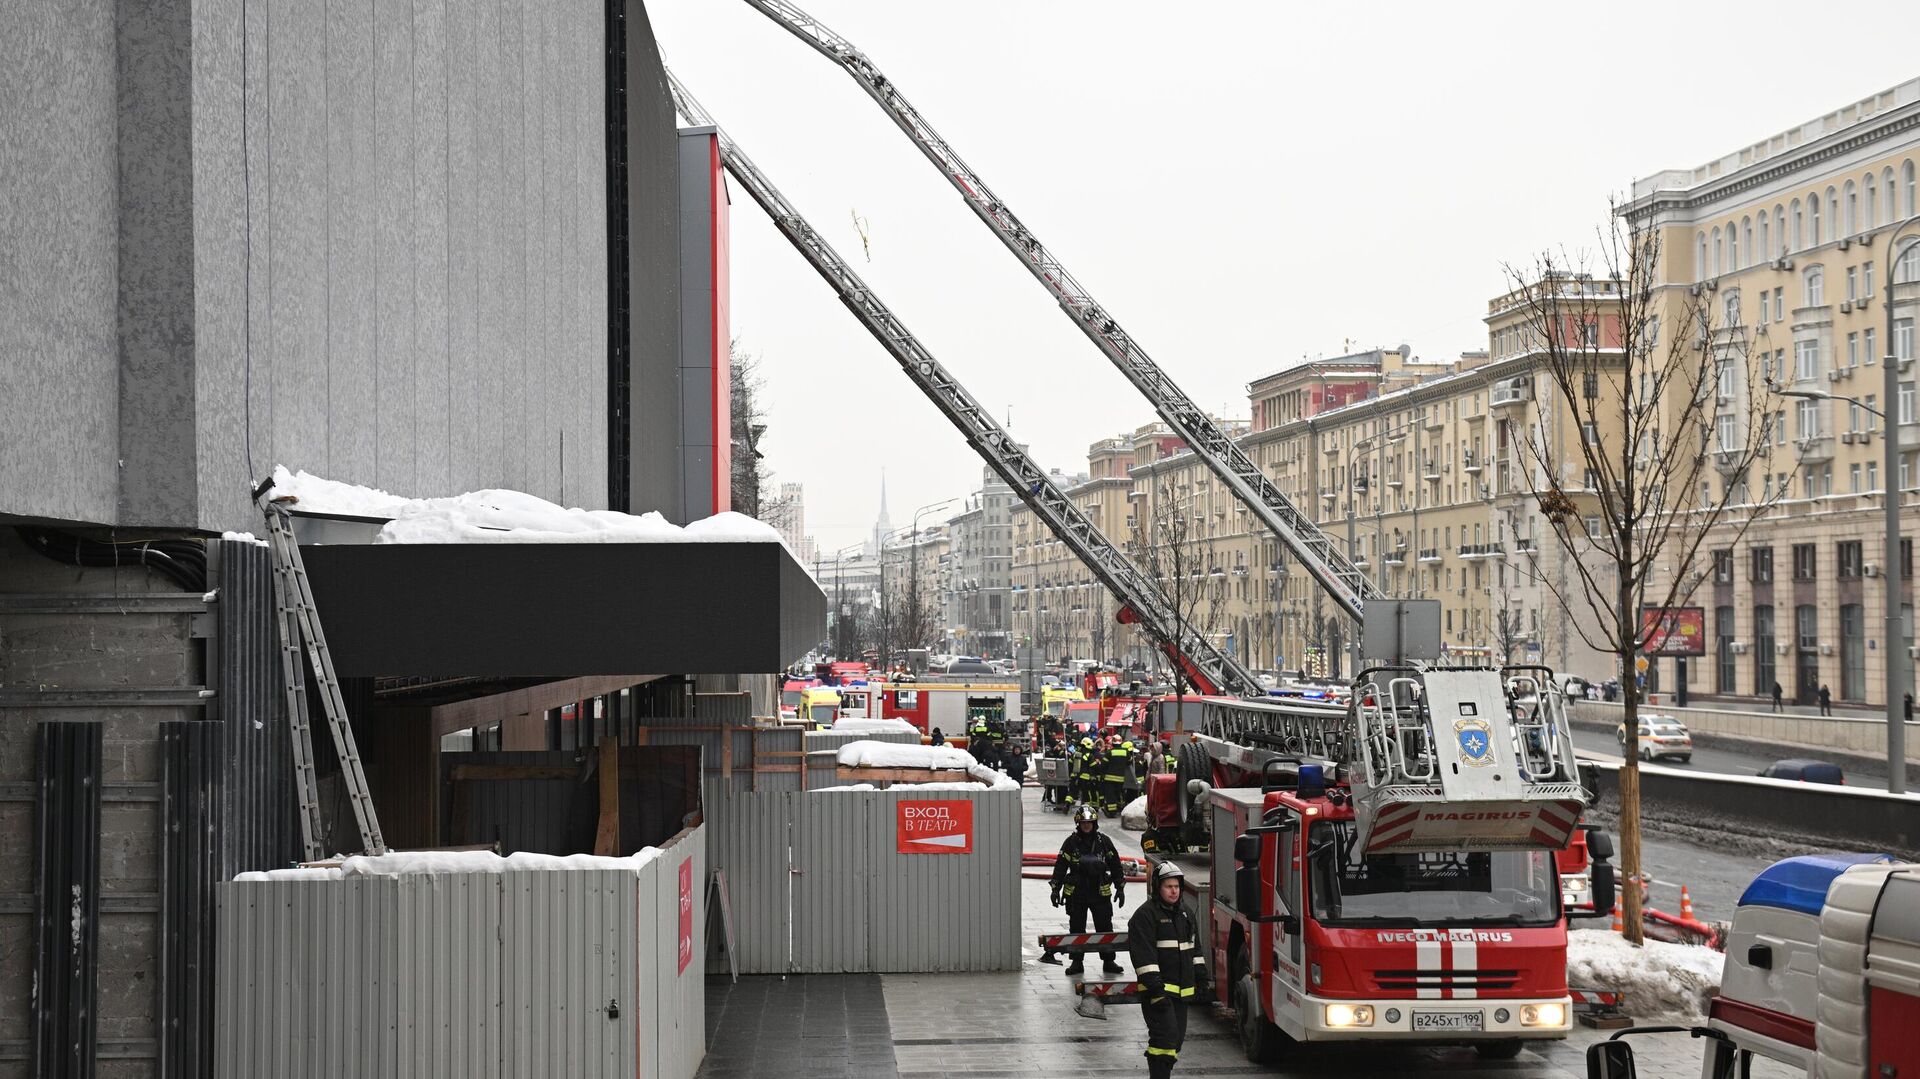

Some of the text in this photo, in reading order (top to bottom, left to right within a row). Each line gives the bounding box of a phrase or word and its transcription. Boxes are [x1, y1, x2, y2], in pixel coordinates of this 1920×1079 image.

[905, 807, 949, 819] ВХОД
[1424, 811, 1532, 821] MAGIRUS
[905, 820, 957, 831] В ТЕАТР
[1376, 932, 1513, 943] IVECO MAGIRUS
[1417, 1015, 1460, 1026] В245ХТ
[1463, 1014, 1479, 1023] 199
